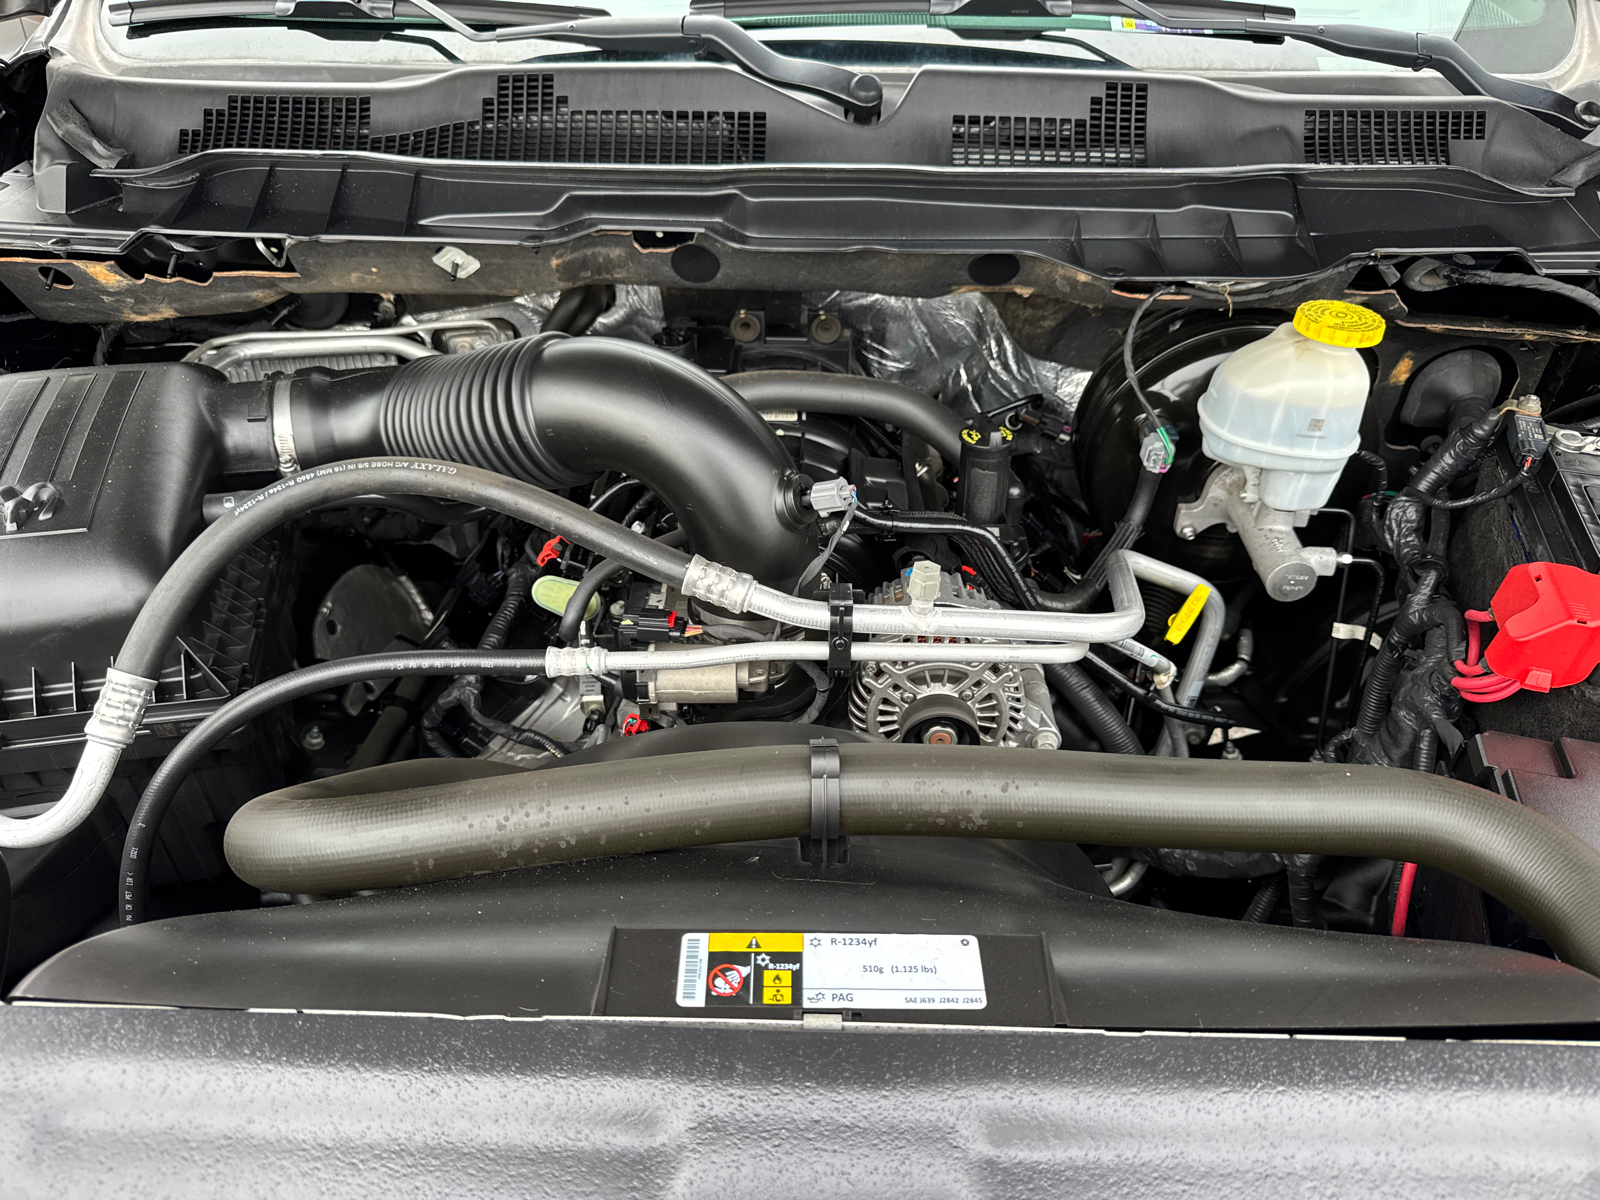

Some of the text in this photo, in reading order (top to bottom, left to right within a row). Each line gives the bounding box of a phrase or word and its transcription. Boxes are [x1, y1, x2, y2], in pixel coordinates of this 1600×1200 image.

[316, 468, 333, 477] MM)
[334, 464, 346, 472] (16
[411, 462, 457, 475] GALAXY
[296, 474, 315, 483] 4860
[268, 480, 295, 494] R-134a
[234, 494, 264, 516] R-1234yf
[1175, 605, 1196, 632] ENGINE
[830, 938, 878, 948] R-1234yf
[768, 963, 800, 972] R-1234yf
[862, 965, 937, 974] 510g (1.125 lbs)
[832, 993, 854, 1002] PAG
